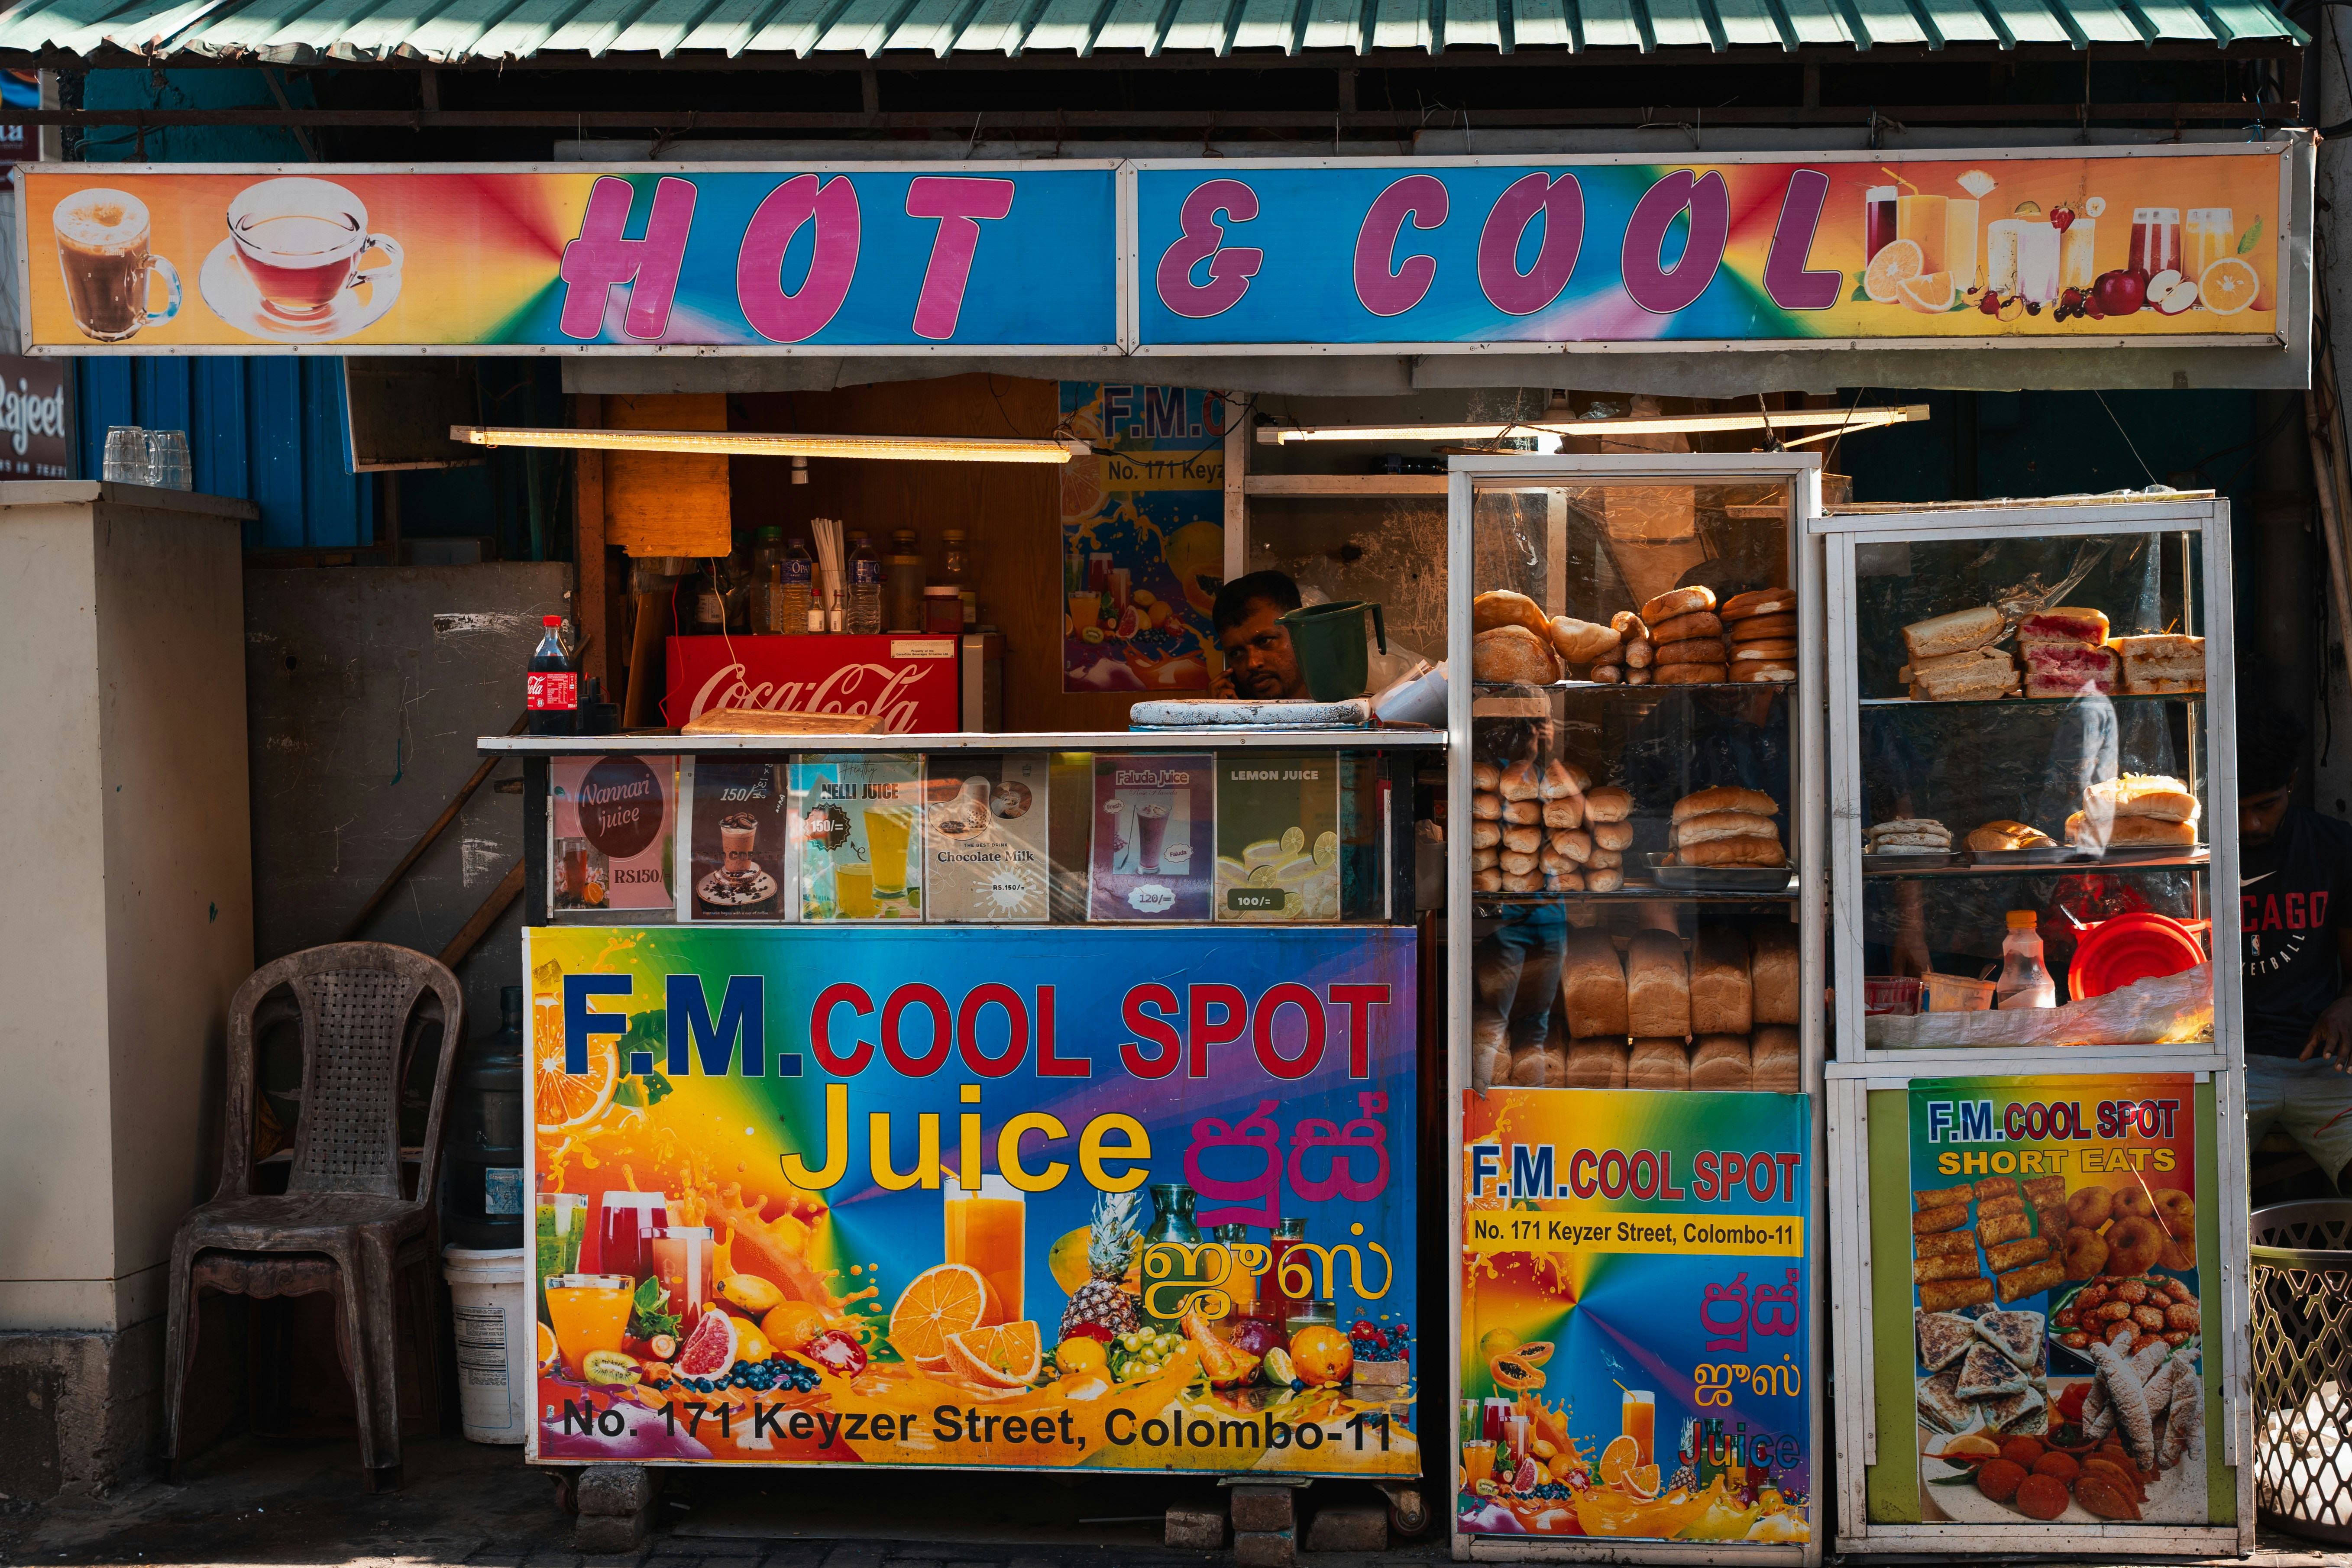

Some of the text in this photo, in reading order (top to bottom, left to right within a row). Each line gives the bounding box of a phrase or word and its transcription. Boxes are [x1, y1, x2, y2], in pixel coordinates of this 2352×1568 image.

[559, 168, 1843, 344] HOT & COOL
[1109, 461, 1138, 480] No.
[1145, 460, 1174, 479] 171
[582, 773, 650, 808] Nannari
[1116, 770, 1189, 787] Faluda Juice
[1231, 770, 1319, 781] LEMON JUICE
[822, 783, 899, 800] NELLI JUICE
[599, 806, 640, 837] juice
[811, 820, 843, 832] 150/=
[937, 850, 1035, 863] Chocolate Milk
[1139, 894, 1171, 904] 120/=
[1238, 896, 1270, 906] 100/=
[1119, 982, 1391, 1080] SPOT
[2096, 1099, 2180, 1139] SPOT
[779, 1083, 1152, 1193] Juice
[1693, 1150, 1802, 1203] SPOT
[1938, 1148, 2176, 1175] SHORT EATS
[1475, 1220, 1792, 1247] No. 171 Keyzer Street, Colombo-11
[1143, 1222, 1393, 1321] ஜூஸ்
[1694, 1353, 1801, 1406] ஜூஸ்
[563, 1399, 637, 1438] No.
[657, 1401, 731, 1438] 171
[755, 1402, 916, 1450] Keyzer
[932, 1405, 1086, 1452] Street,
[1104, 1408, 1389, 1451] Colombo-11
[1678, 1421, 1800, 1468] Juice
